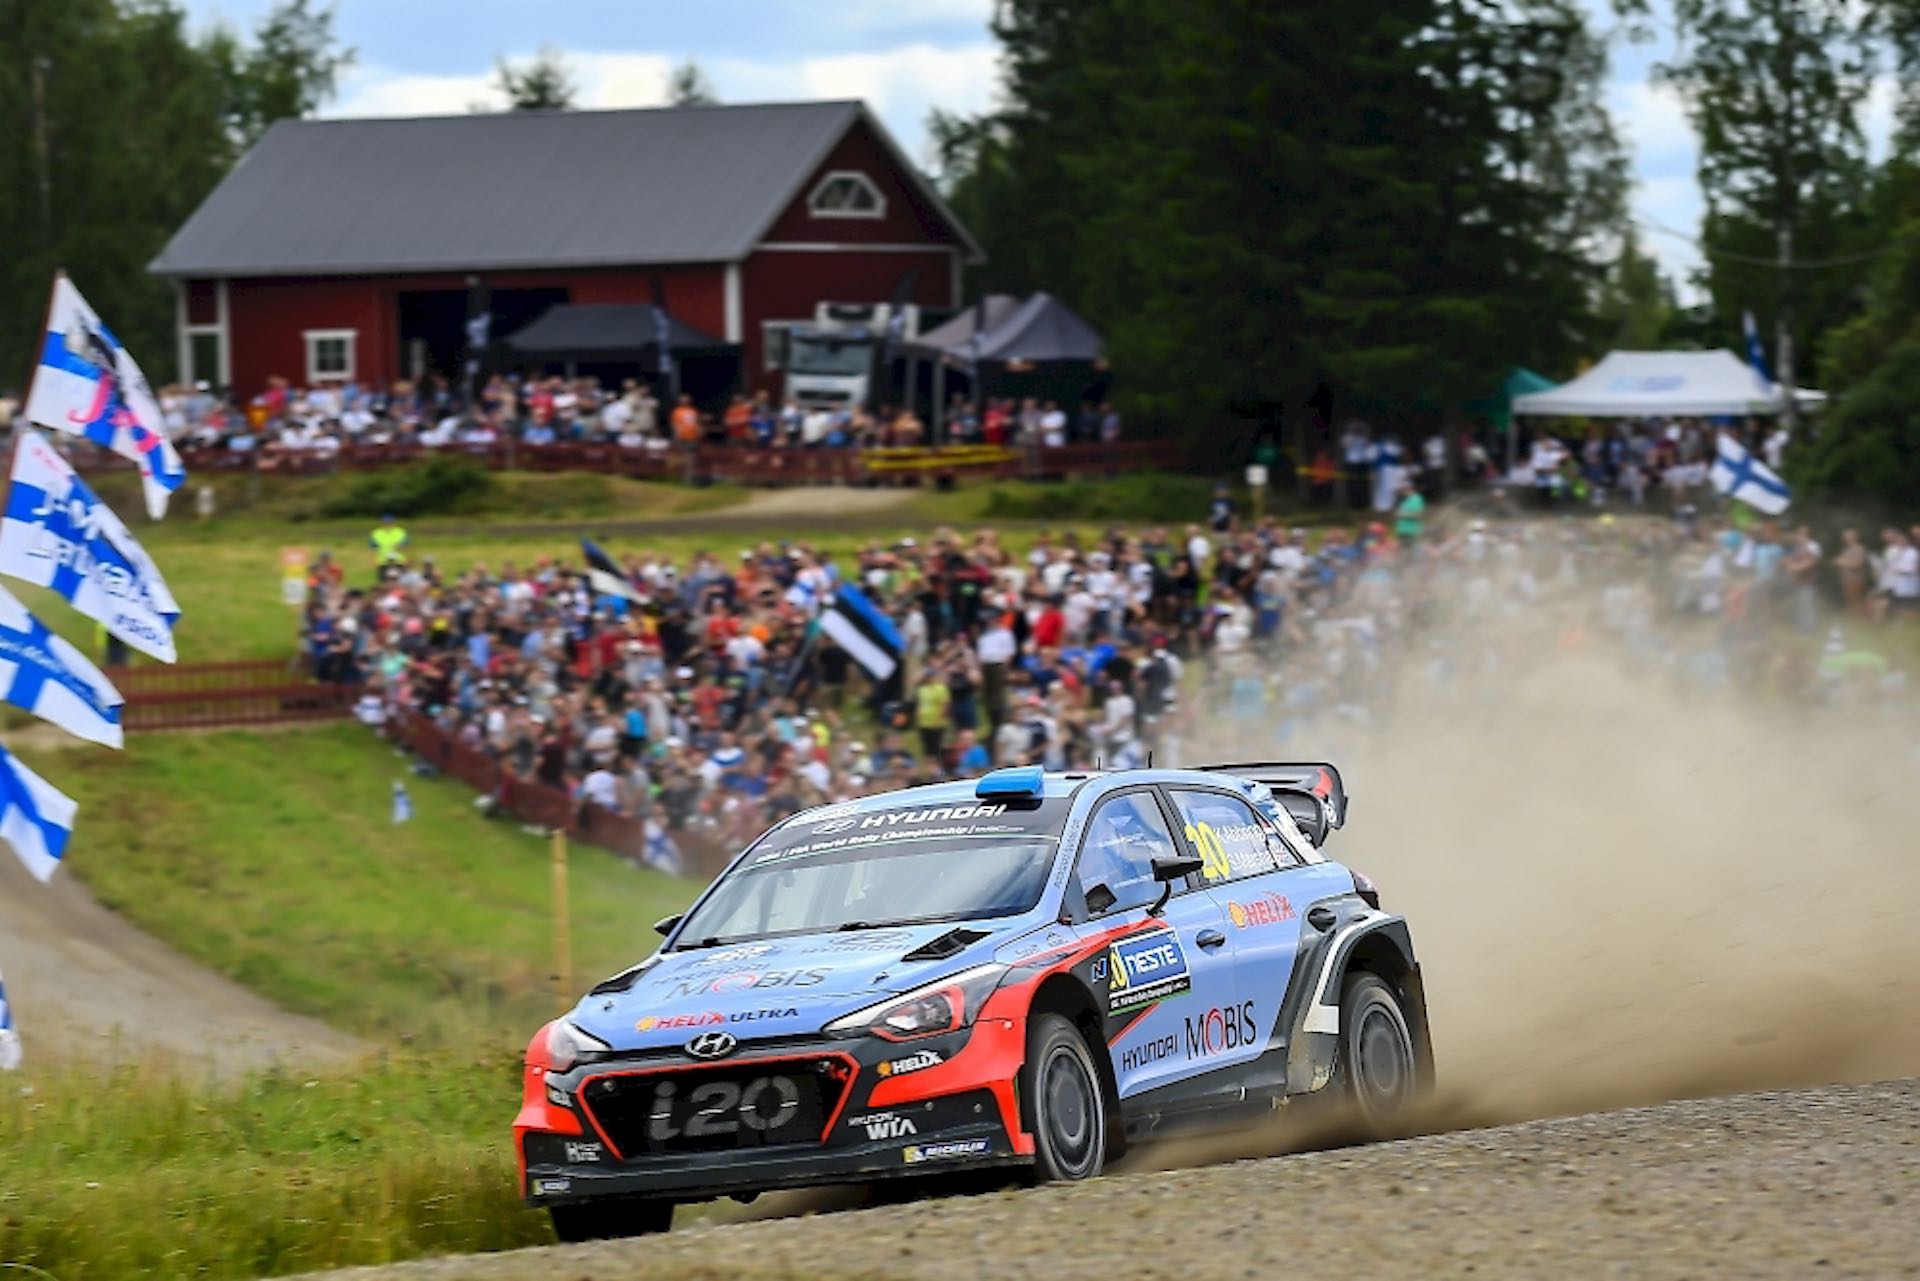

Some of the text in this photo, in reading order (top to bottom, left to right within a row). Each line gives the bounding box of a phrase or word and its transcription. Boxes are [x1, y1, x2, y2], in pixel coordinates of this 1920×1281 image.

[859, 803, 1008, 830] HYUNDAI
[1183, 820, 1230, 880] 20
[1243, 890, 1297, 927] HELIX
[664, 967, 834, 1001] MOBIS
[656, 1006, 800, 1029] HELIX ULTRA
[1121, 1000, 1258, 1073] HYUNDAI MOBIS
[891, 1050, 945, 1075] HELIX
[648, 1075, 800, 1141] i20
[865, 1116, 918, 1140] WIA
